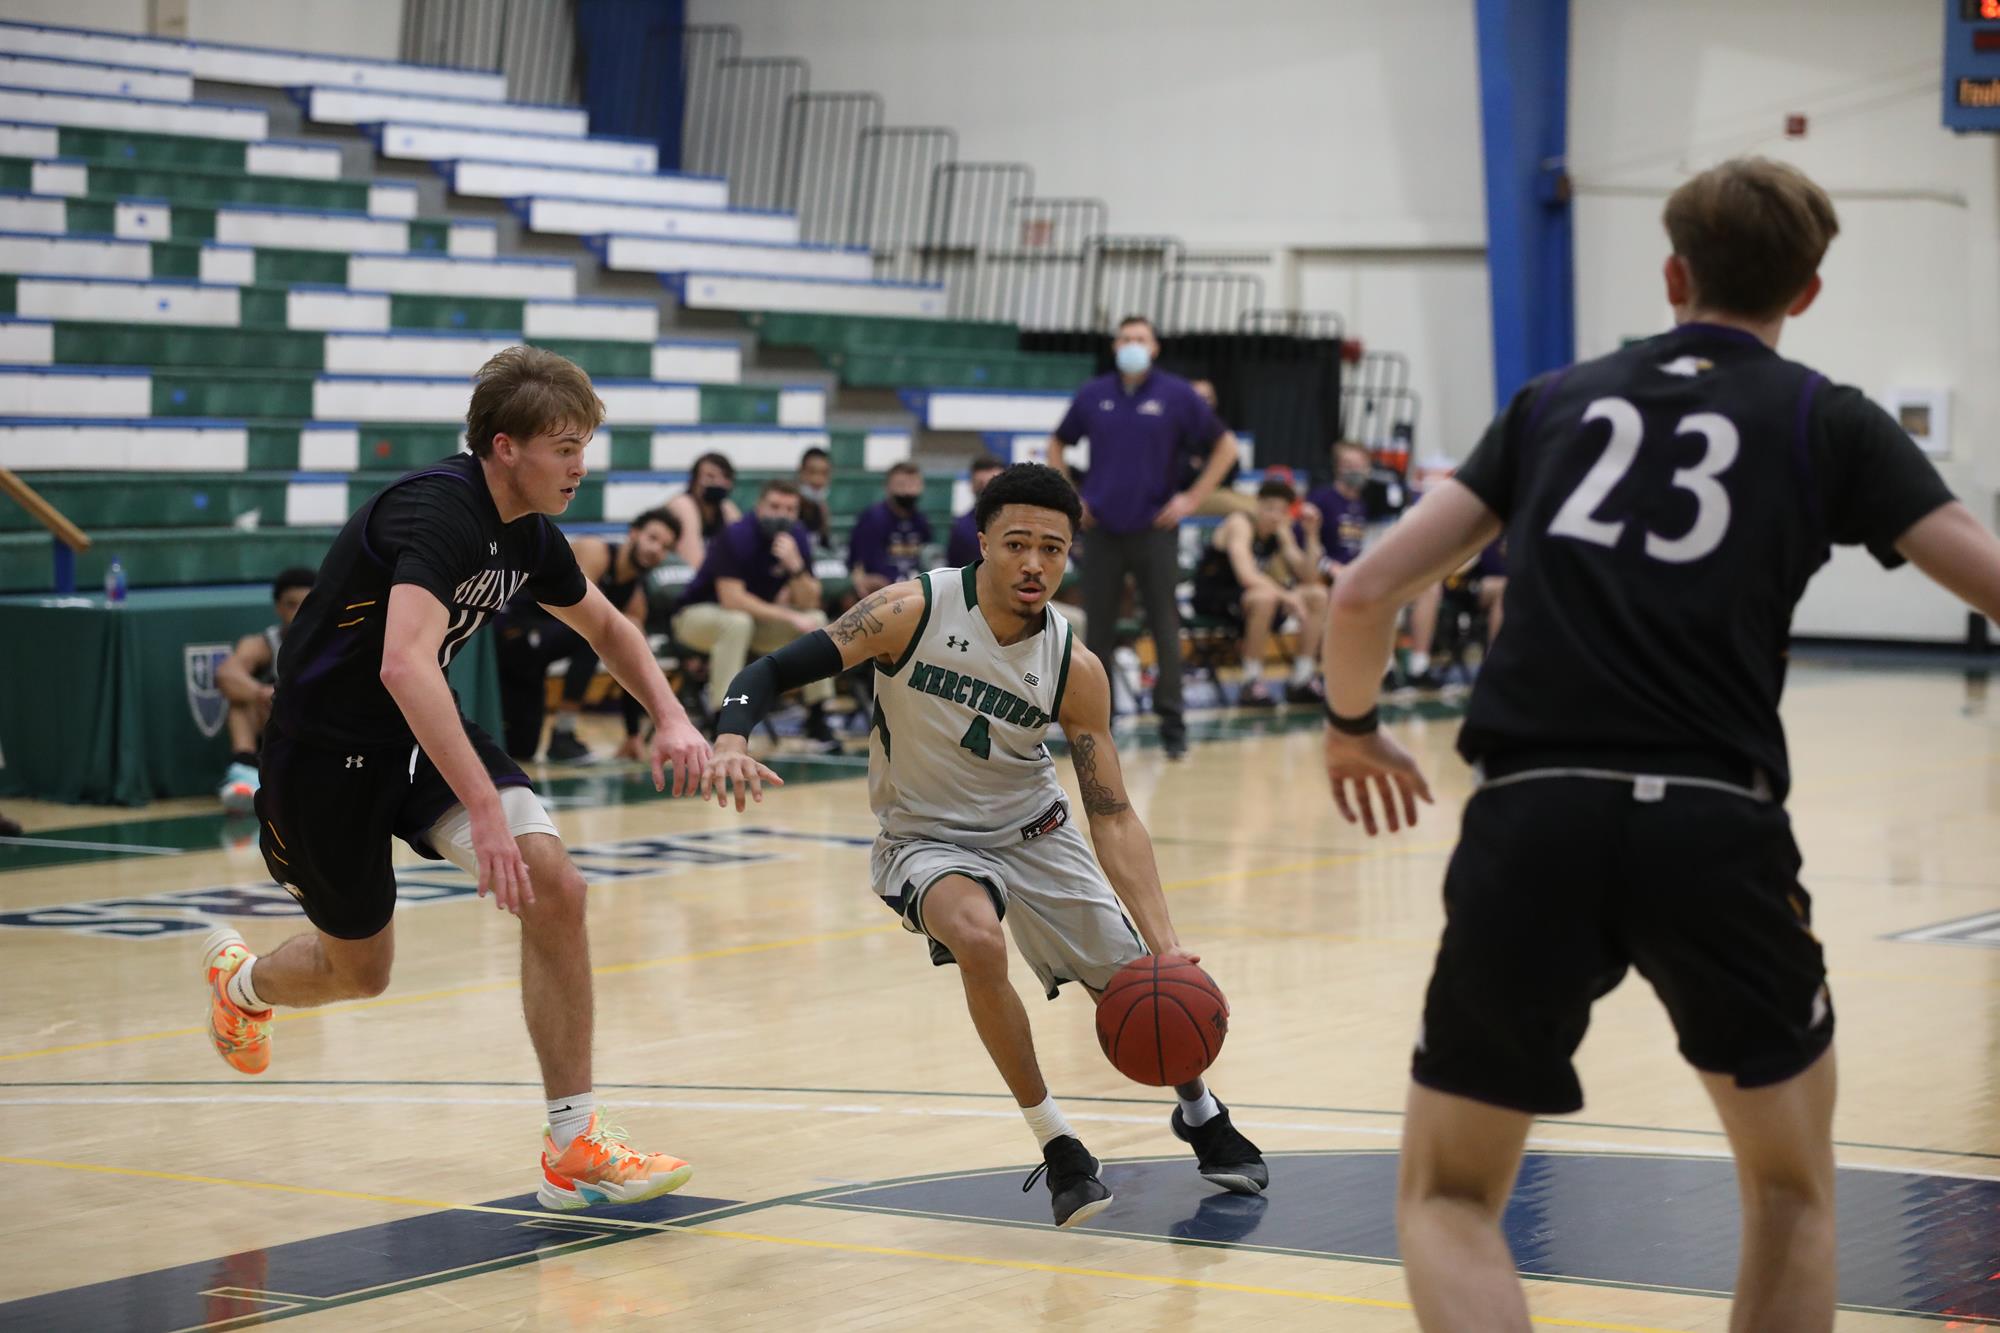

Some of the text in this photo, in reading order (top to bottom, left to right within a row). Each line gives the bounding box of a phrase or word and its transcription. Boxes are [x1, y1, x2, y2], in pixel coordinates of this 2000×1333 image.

[1547, 396, 1740, 564] 23
[907, 660, 1051, 729] MERCYHURST
[960, 714, 992, 760] 4
